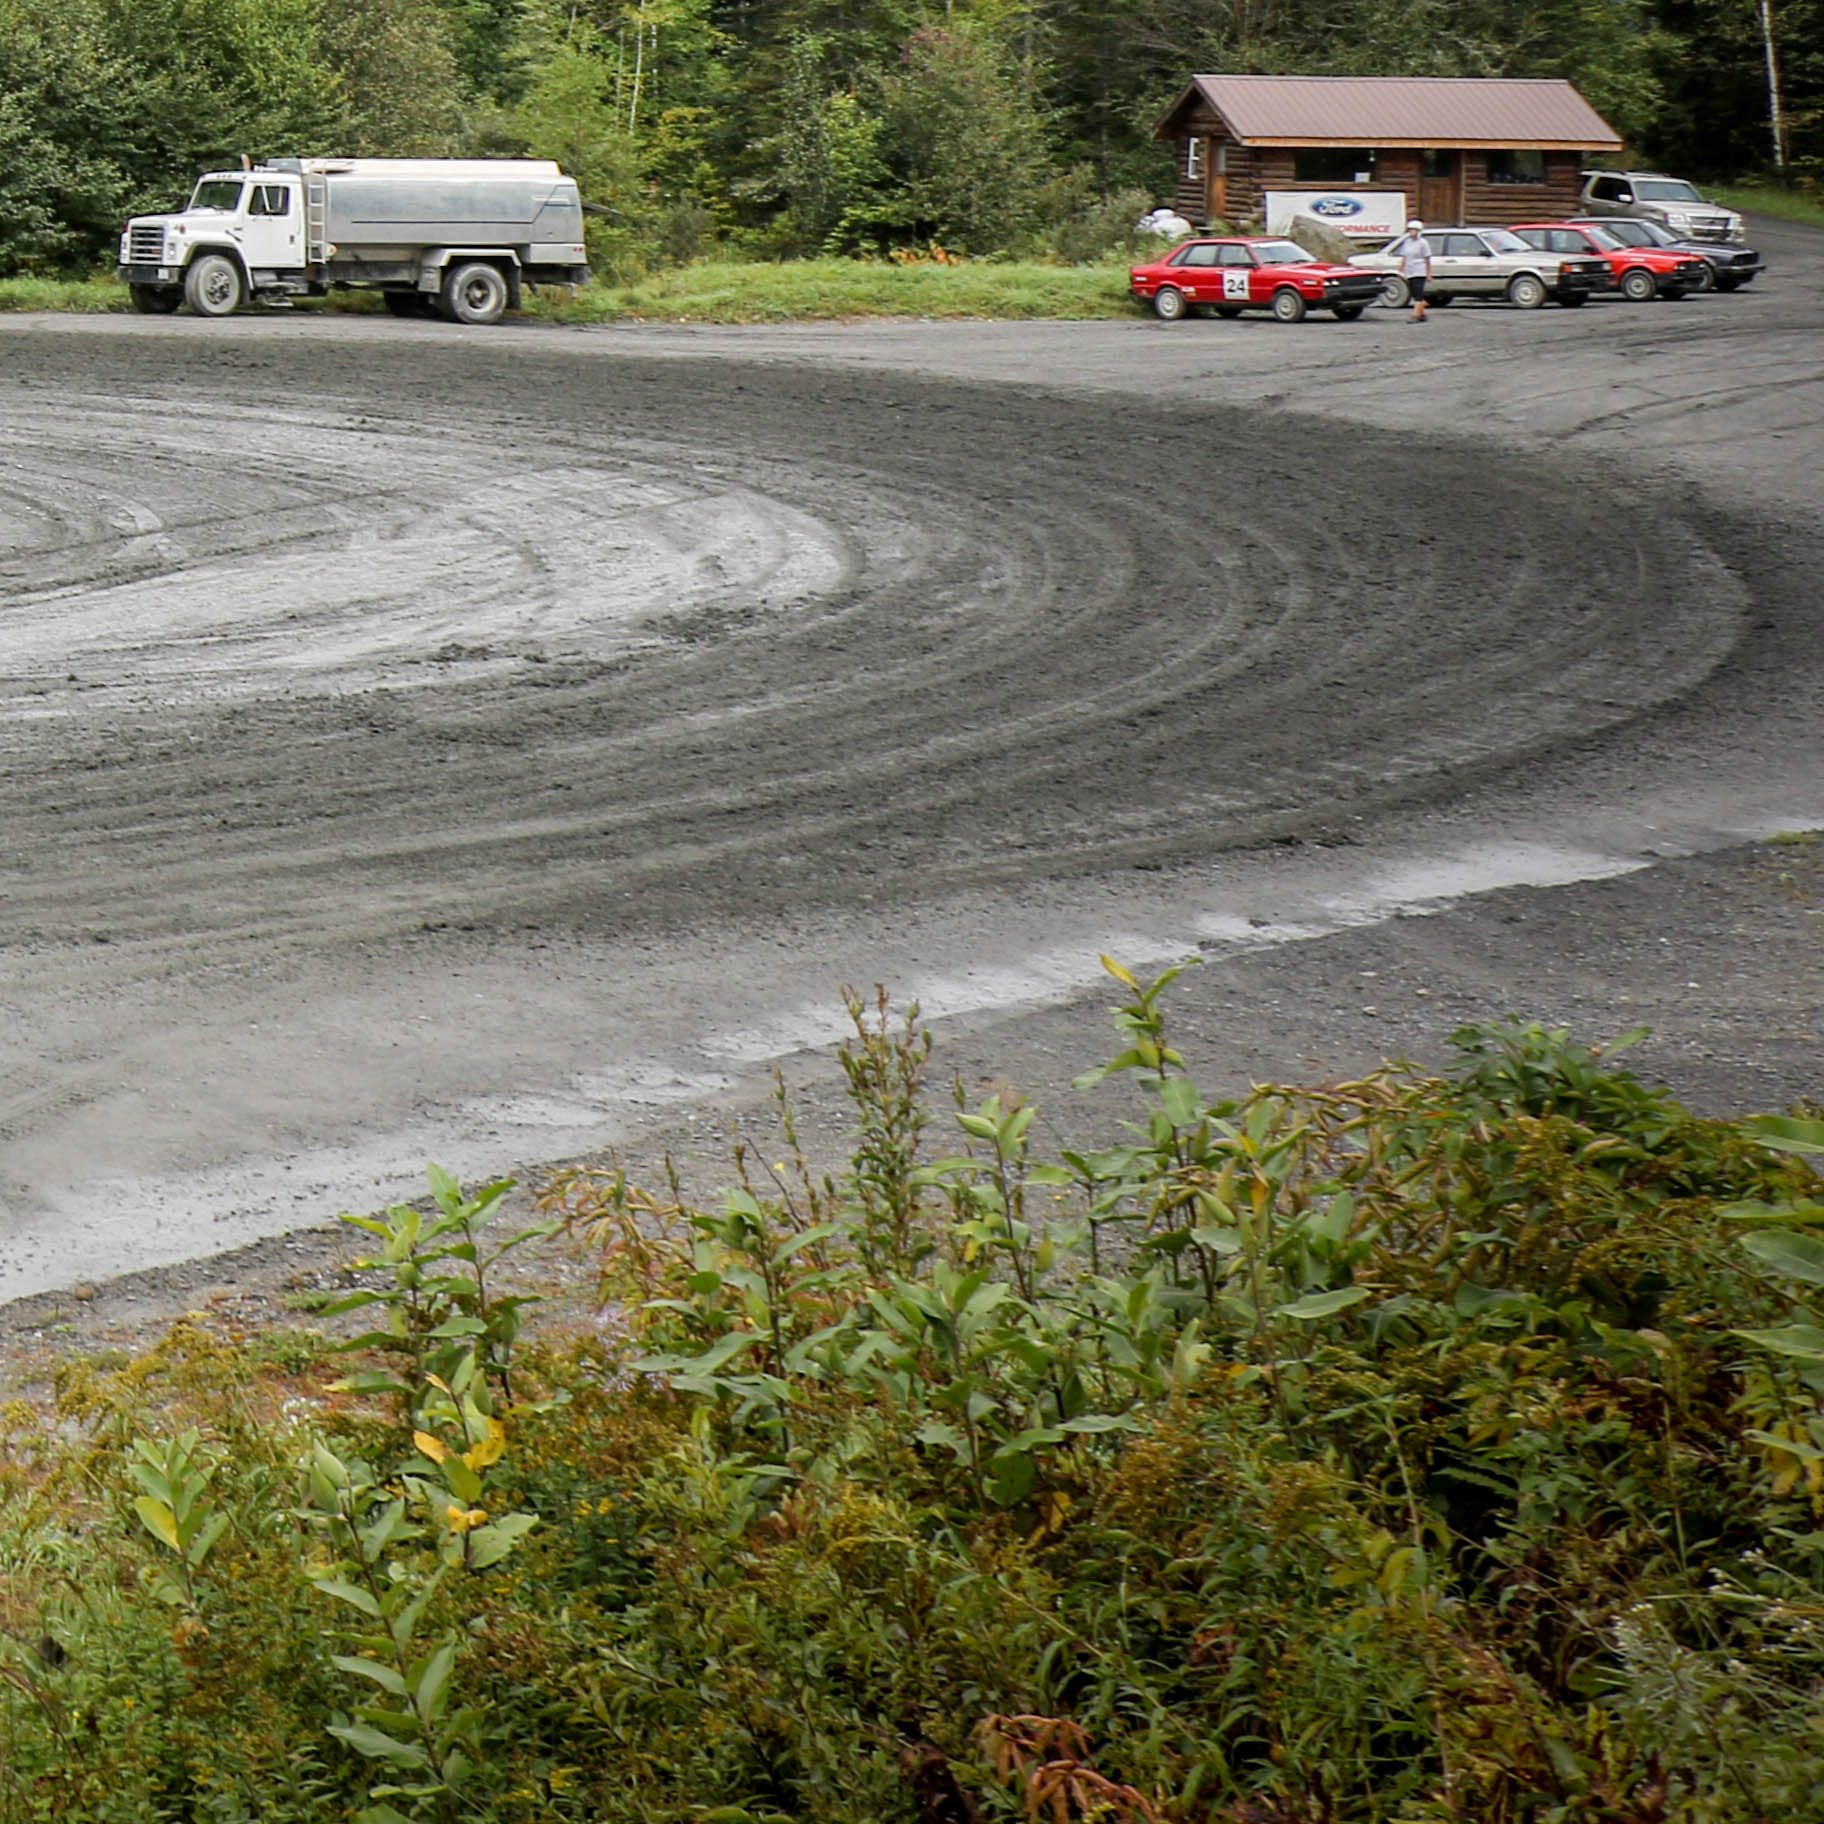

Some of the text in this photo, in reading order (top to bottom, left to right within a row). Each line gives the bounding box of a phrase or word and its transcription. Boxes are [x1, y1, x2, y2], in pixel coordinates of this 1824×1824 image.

[1318, 199, 1354, 214] Ford
[1336, 224, 1392, 233] ORMANCE
[1227, 278, 1245, 293] 24
